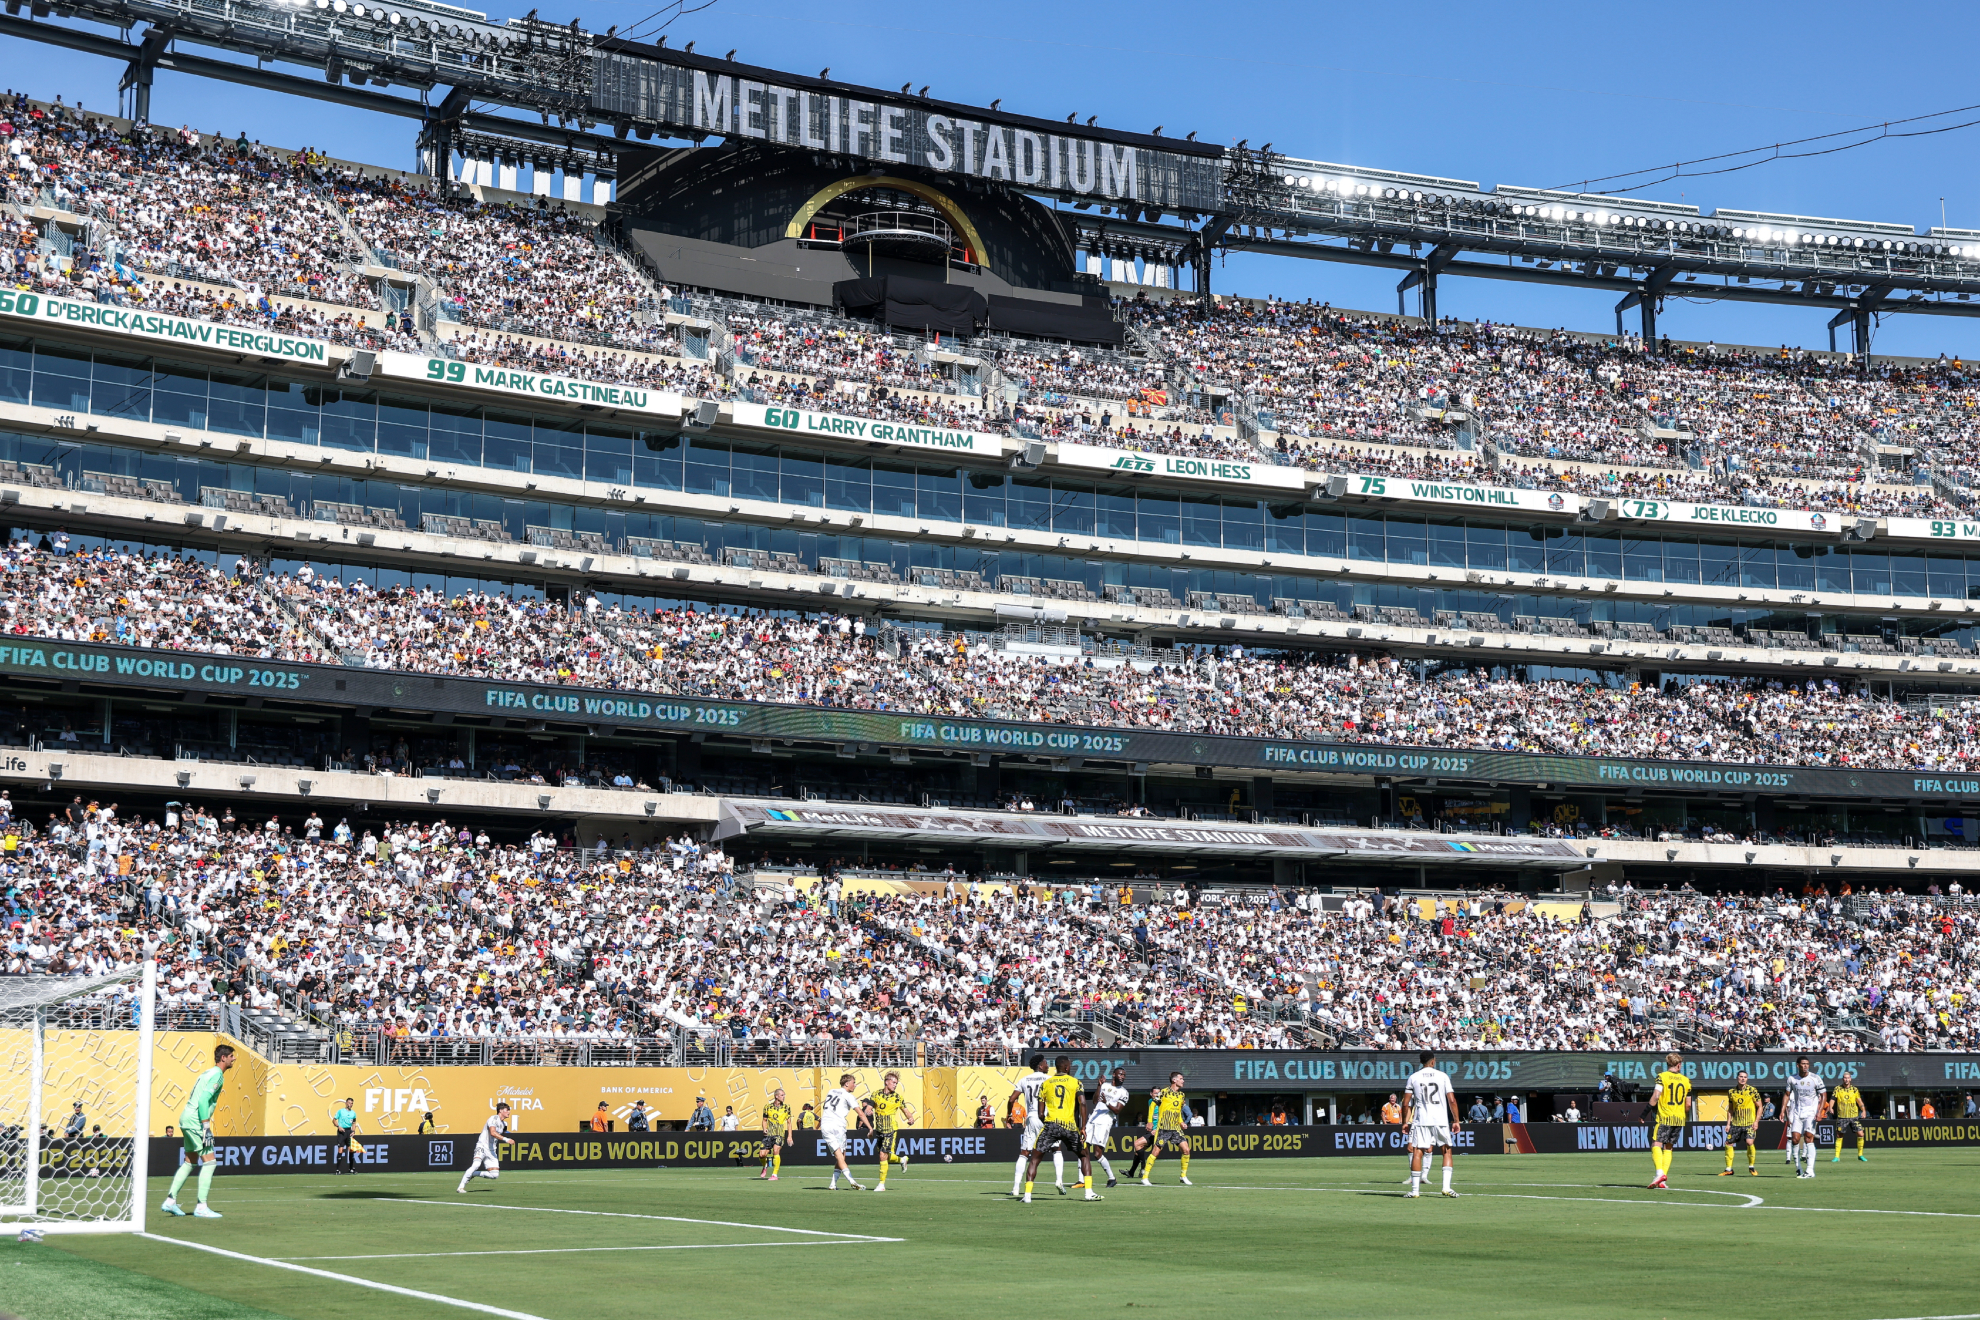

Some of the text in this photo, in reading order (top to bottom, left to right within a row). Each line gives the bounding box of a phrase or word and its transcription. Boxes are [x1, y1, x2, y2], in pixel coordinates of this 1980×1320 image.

[693, 69, 1138, 200] METLIFE STADIUM
[215, 327, 325, 361] FERGUSON
[427, 358, 648, 408] 99 MARK GASTINEAU
[764, 407, 974, 450] 60 LARRY GRANTHAM
[1110, 454, 1251, 480] JETS LEON HESS
[1359, 476, 1520, 506] 75 WINSTON HILL
[1633, 501, 1778, 525] 73 JOE KLECKO
[1931, 521, 1956, 537] 93
[0, 646, 47, 667] FIFA
[52, 651, 110, 673] CLUB
[115, 656, 196, 680] WORLD
[200, 665, 244, 684] CUP
[486, 690, 528, 709] FIFA
[531, 693, 580, 713] CLUB
[584, 697, 652, 719] WORLD
[655, 704, 691, 722] CUP
[901, 722, 936, 740] FIFA
[940, 725, 982, 743] CLUB
[984, 728, 1044, 747] WORLD
[1046, 733, 1080, 749] CUP
[1265, 747, 1298, 763] FIFA
[1300, 749, 1339, 765] CLUB
[1341, 752, 1396, 769] WORLD
[1399, 755, 1429, 771] CUP
[1599, 765, 1630, 780] FIFA
[1632, 767, 1669, 782] CLUB
[1671, 768, 1722, 784] WORLD
[1724, 770, 1752, 786] CUP
[1914, 779, 1980, 794] FIFA CLUB
[801, 811, 883, 825] MetLife
[1079, 824, 1274, 845] METLIFE STADIUM
[1476, 842, 1546, 855] MetLife
[1235, 1060, 1279, 1080] FIFA
[1283, 1060, 1336, 1080] CLUB
[1341, 1060, 1414, 1080] WORLD
[1607, 1061, 1647, 1080] FIFA
[1701, 1061, 1769, 1080] WORLD
[1772, 1061, 1798, 1079] CU
[1944, 1062, 1980, 1080] FIFA
[365, 1088, 430, 1113] FIFA
[496, 1085, 534, 1097] Michelob
[601, 1086, 674, 1094] BANK OF AMERICA
[1054, 1084, 1066, 1110] 9
[1419, 1082, 1441, 1105] 12
[1667, 1082, 1686, 1106] 10
[823, 1094, 841, 1112] 24
[1227, 1134, 1260, 1151] CUP
[1334, 1132, 1386, 1149] EVERY
[1577, 1126, 1609, 1150] NEW
[1612, 1126, 1650, 1149] YORK
[1887, 1126, 1920, 1141] CLUB
[1921, 1125, 1966, 1141] WORLD
[261, 1144, 327, 1165] GAME
[498, 1142, 544, 1162] FIFA
[548, 1142, 602, 1161] CLUB
[607, 1141, 679, 1160] WORLD
[684, 1140, 724, 1159] CUP
[816, 1138, 878, 1157] EERY
[895, 1137, 936, 1155] AME
[940, 1136, 986, 1155] FREE
